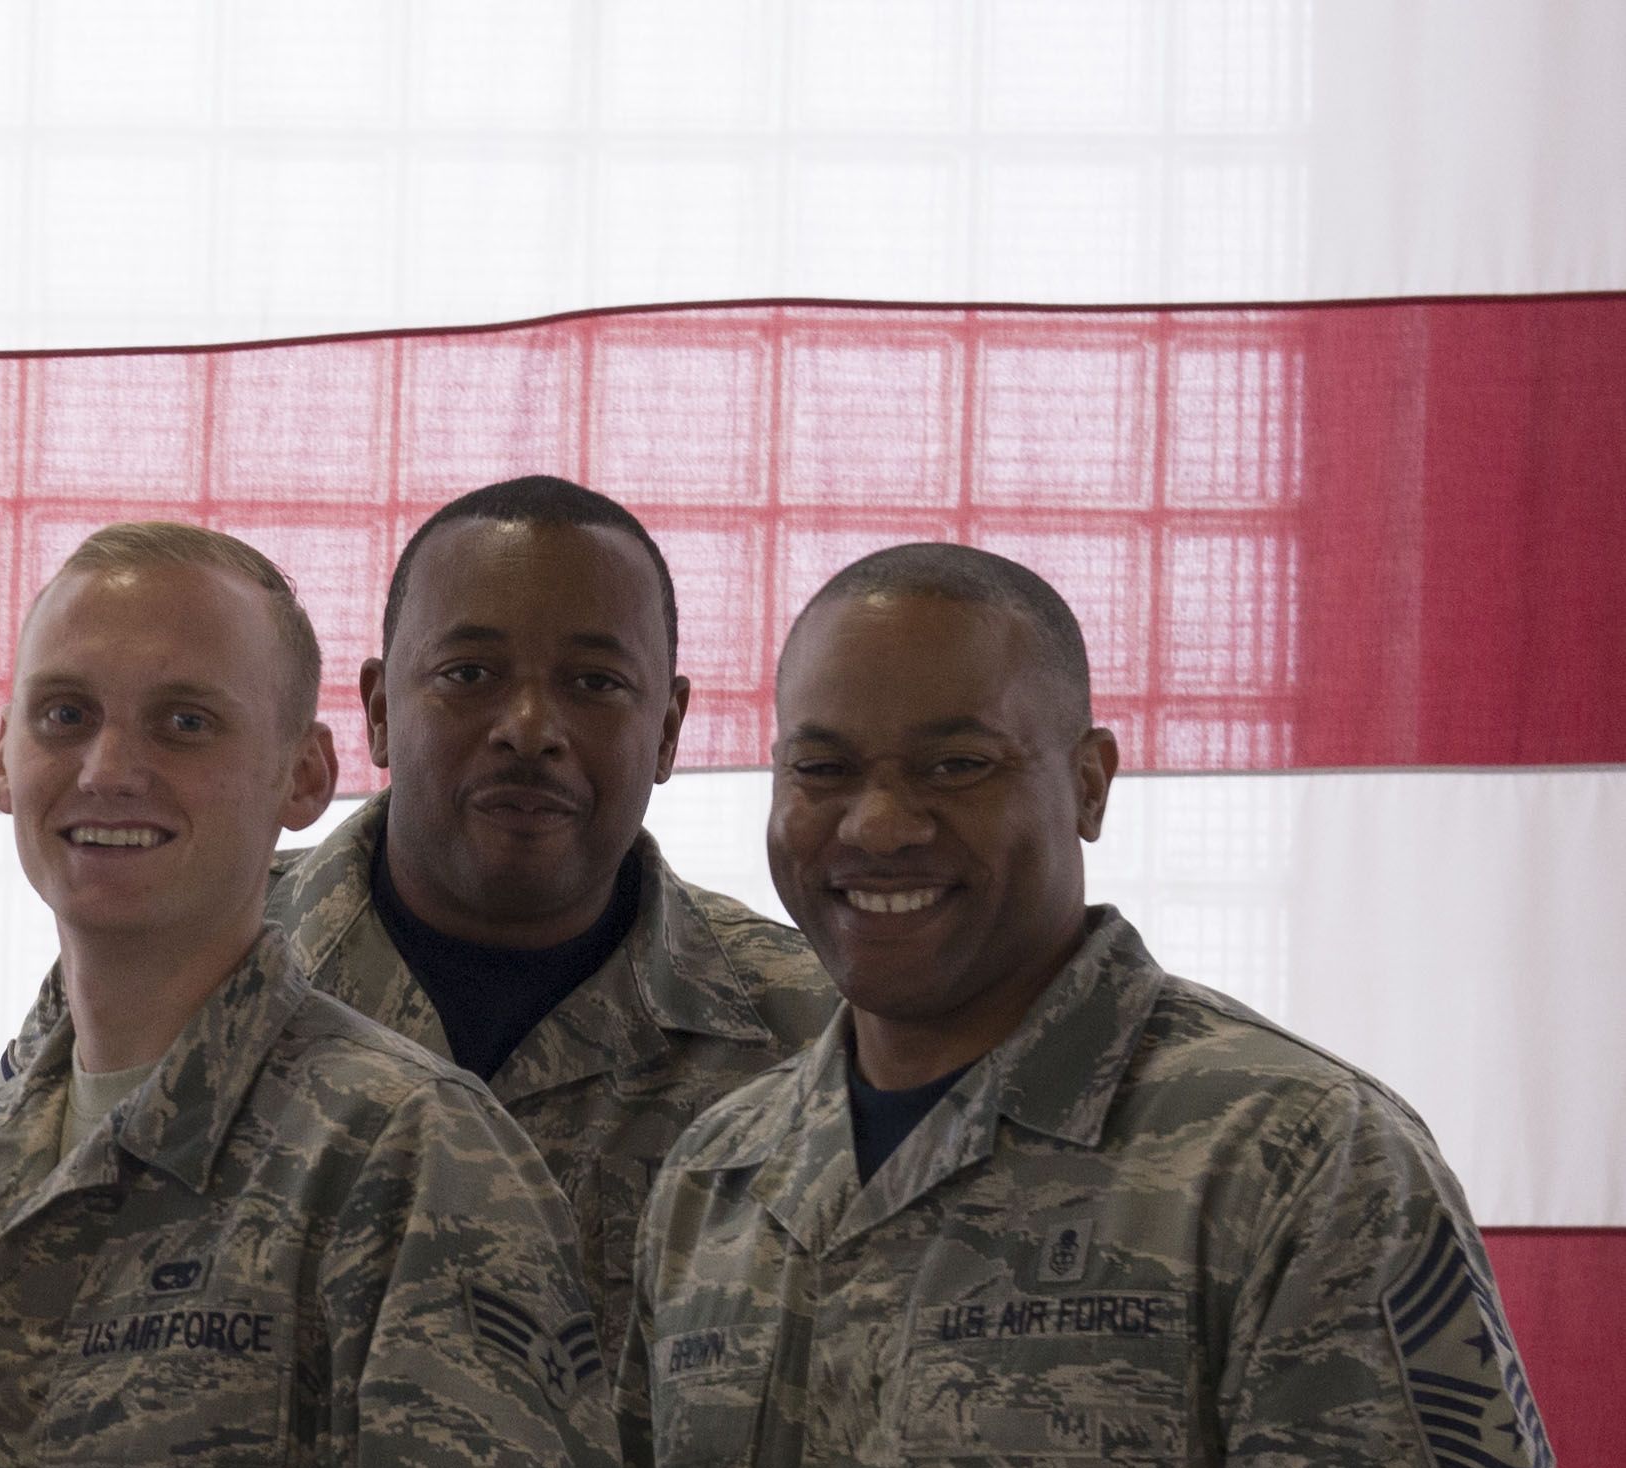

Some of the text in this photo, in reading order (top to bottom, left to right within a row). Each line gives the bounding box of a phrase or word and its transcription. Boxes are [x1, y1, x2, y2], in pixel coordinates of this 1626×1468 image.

[121, 1313, 165, 1352] AIR
[165, 1310, 274, 1353] FORCE
[999, 1300, 1047, 1335] AIR
[1057, 1295, 1163, 1339] FORCE
